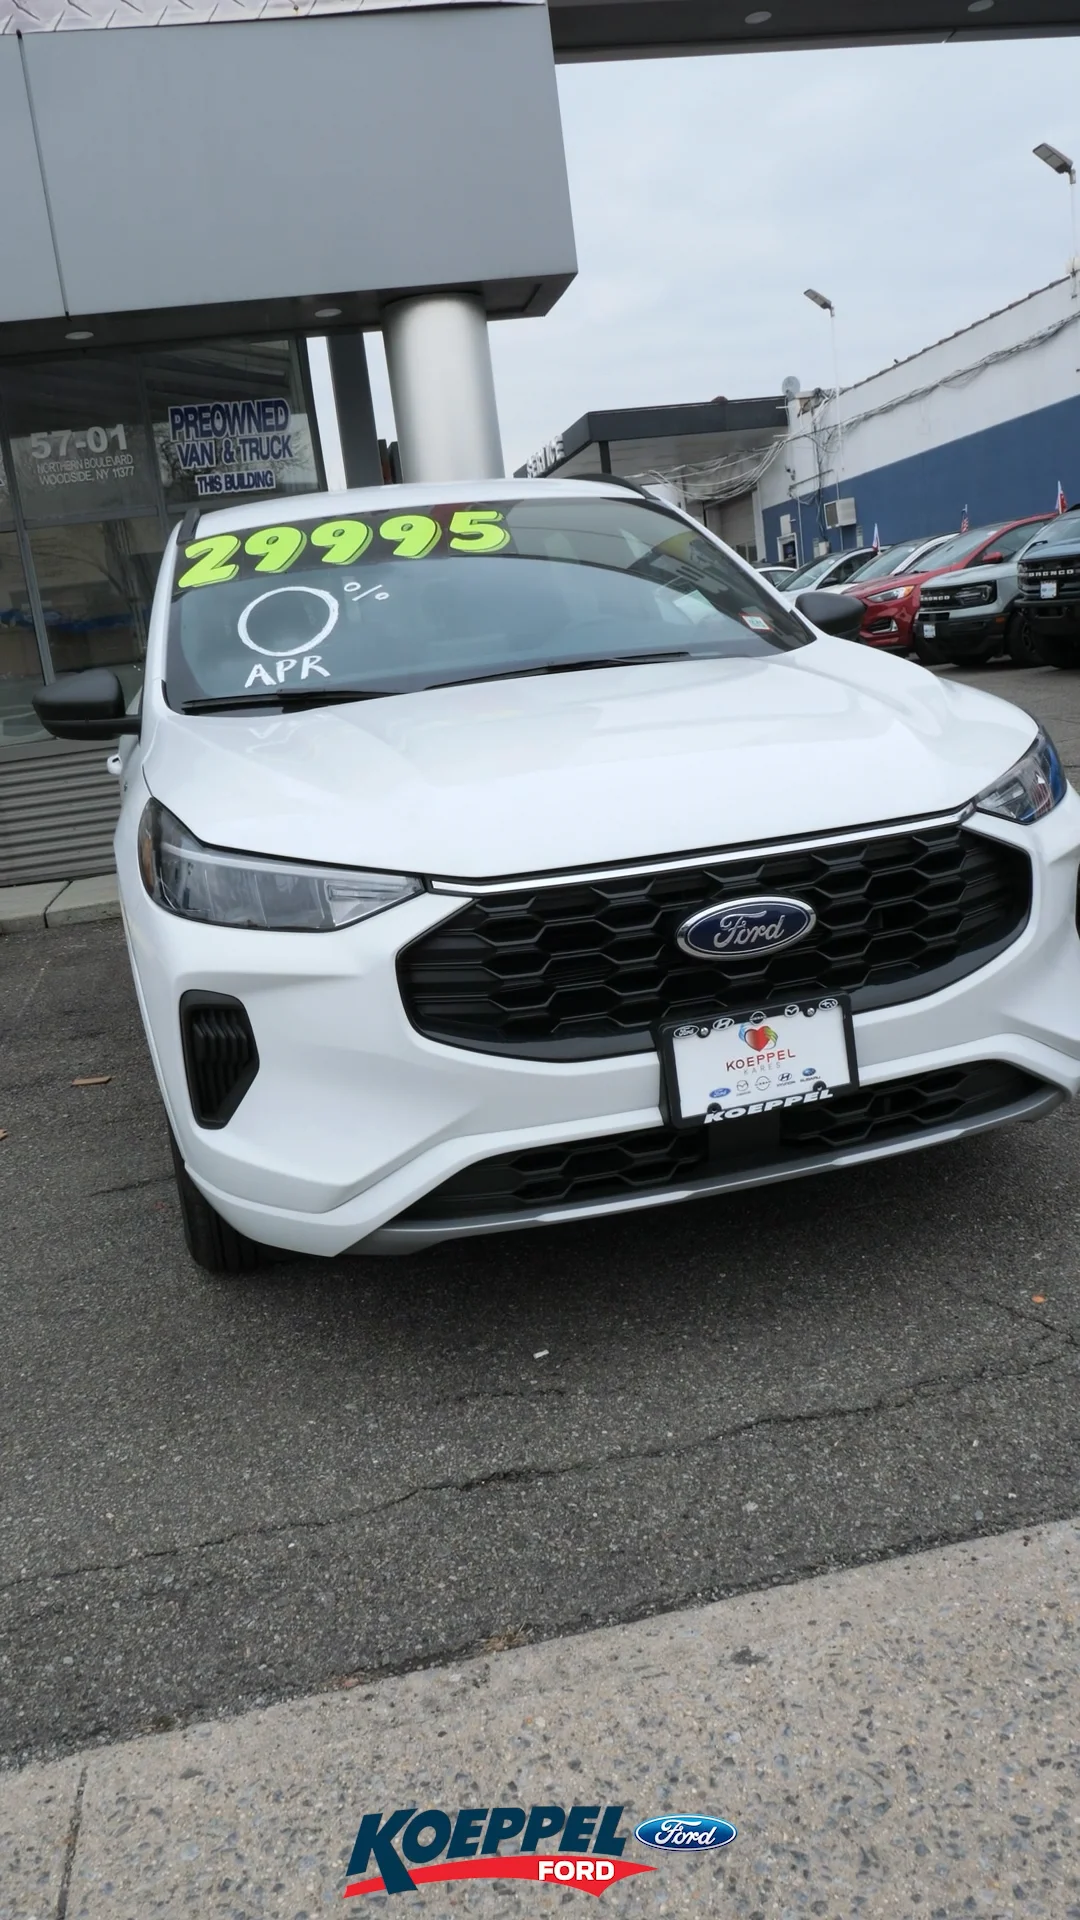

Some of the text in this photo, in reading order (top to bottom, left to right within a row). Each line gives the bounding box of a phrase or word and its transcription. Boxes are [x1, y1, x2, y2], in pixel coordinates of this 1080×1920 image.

[168, 398, 291, 441] PREOWNED
[30, 424, 127, 458] 57-01
[177, 435, 293, 469] VAN & TRUCK
[37, 454, 133, 474] NORTHERN BOULEVARD
[96, 467, 110, 480] NY
[112, 466, 135, 478] 11377
[196, 470, 275, 495] THIS BUILDING
[178, 510, 511, 588] 29995
[1028, 569, 1075, 577] BRONCO
[244, 655, 331, 688] APR
[713, 910, 786, 948] Ford
[726, 1048, 796, 1072] KOEPPEL
[743, 1061, 781, 1076] KARES
[704, 1089, 834, 1124] KOEPPEL
